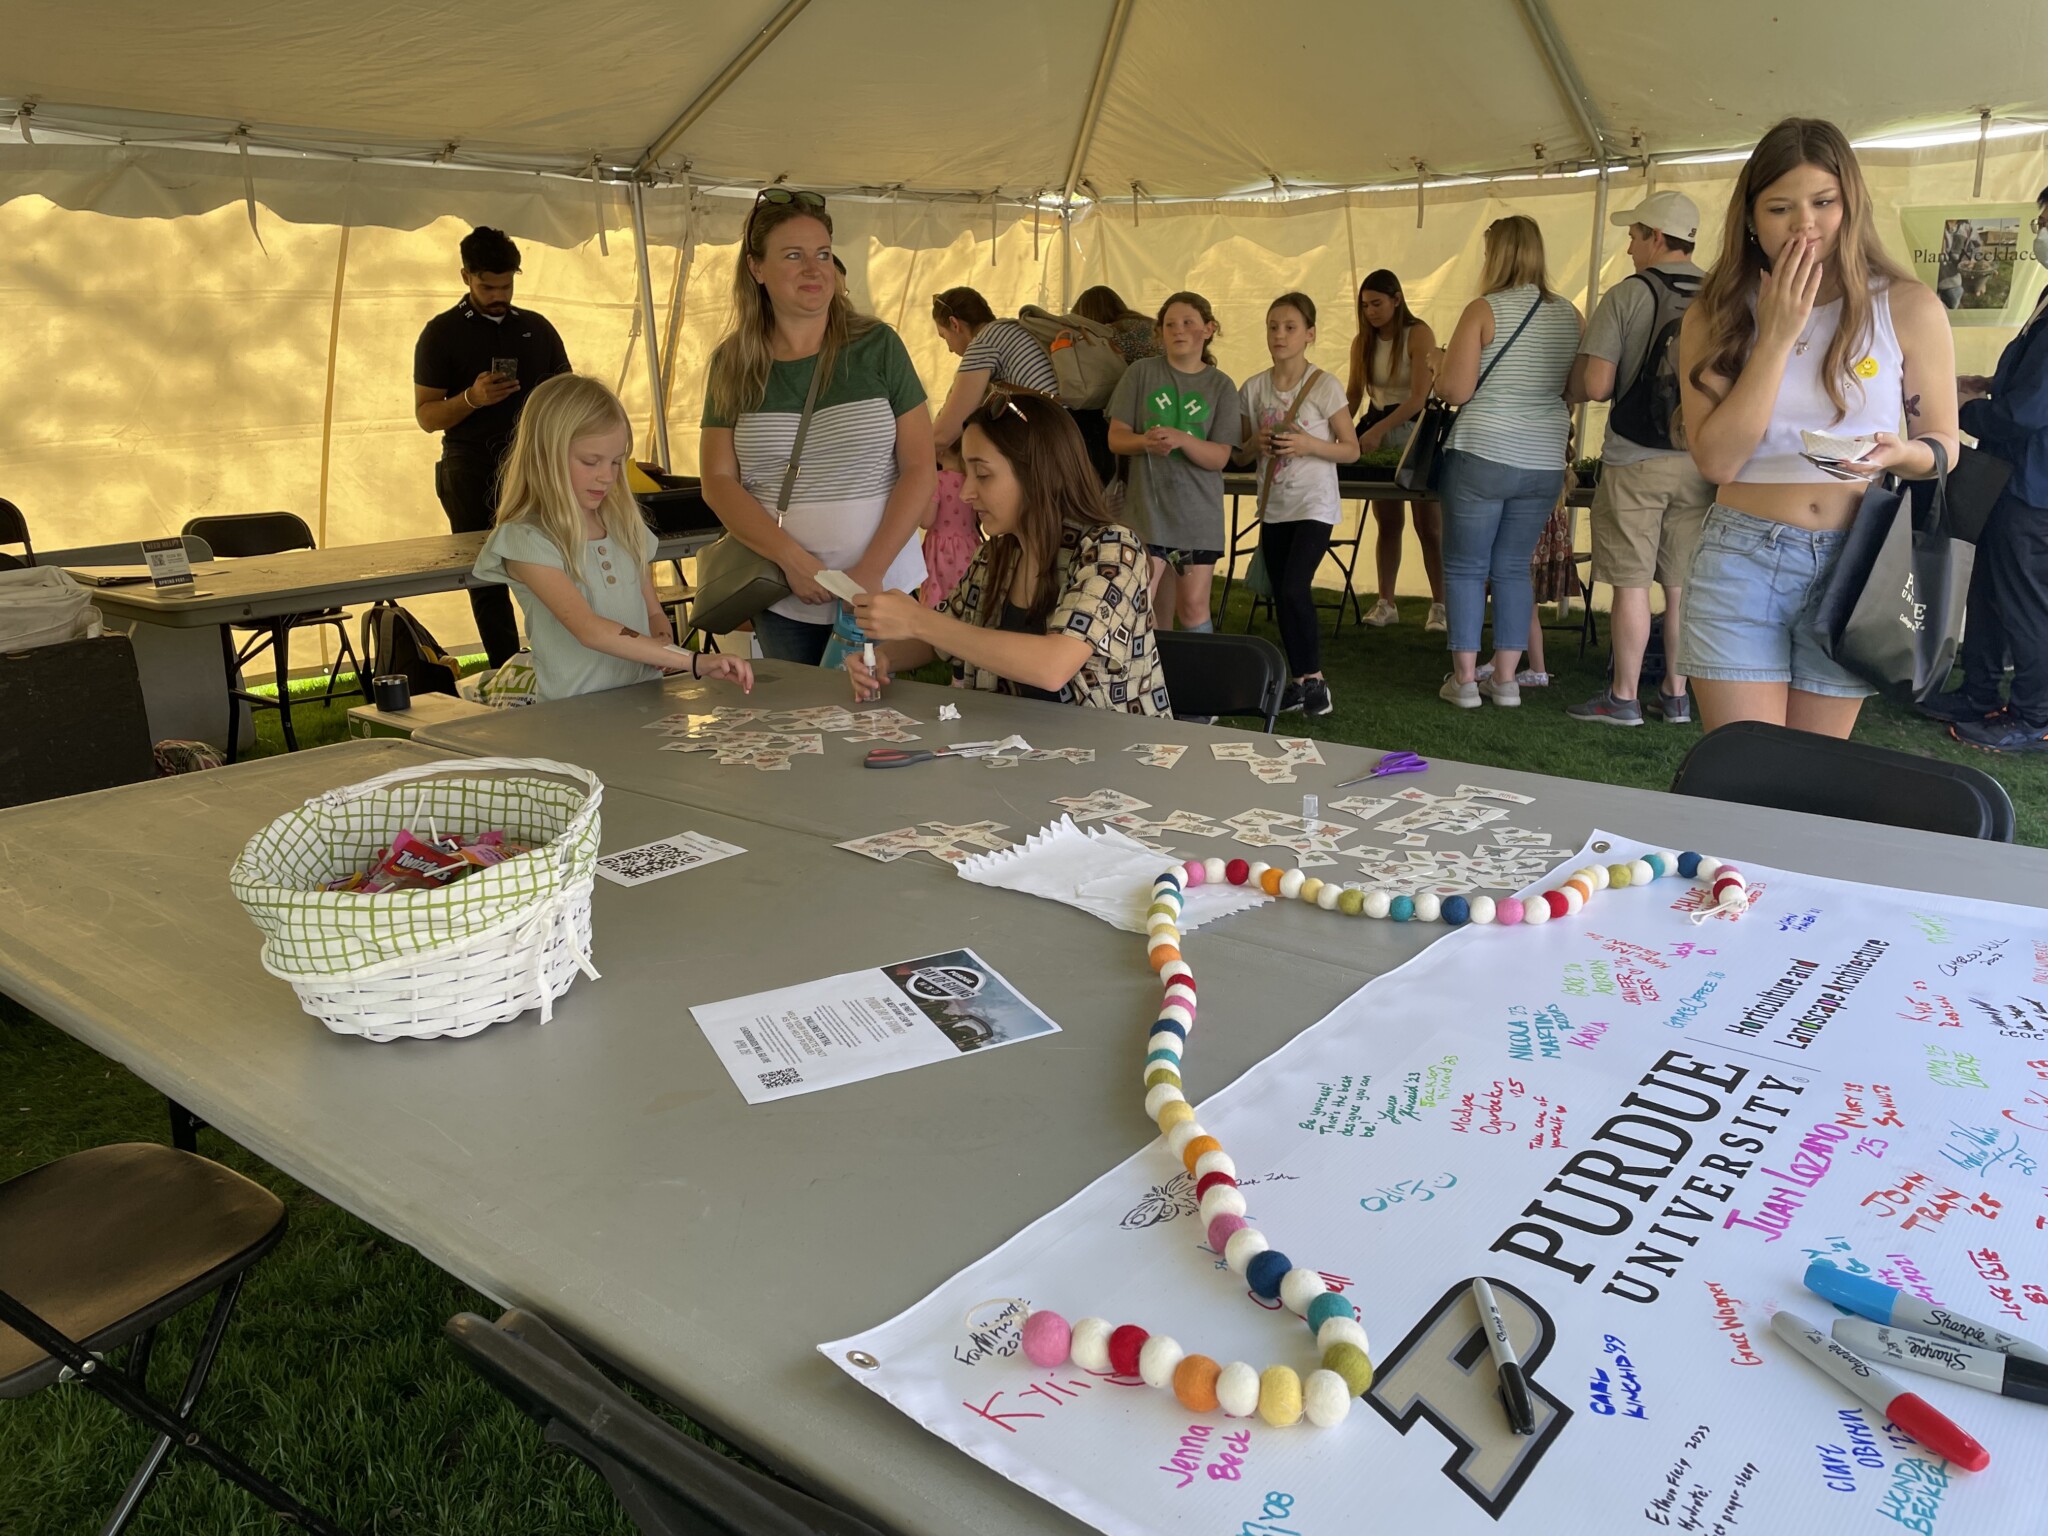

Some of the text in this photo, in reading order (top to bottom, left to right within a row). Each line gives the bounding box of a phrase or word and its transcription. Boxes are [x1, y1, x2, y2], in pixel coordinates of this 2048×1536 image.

[1155, 392, 1172, 410] H
[1184, 399, 1202, 416] H
[916, 967, 942, 978] DAY
[940, 981, 976, 998] GIVING
[1636, 977, 1663, 1002] KERR
[1724, 957, 1821, 1038] Horticulture and
[1772, 939, 1891, 1050] Landscape Architecture
[1507, 1020, 1534, 1062] NICOLA
[1566, 1021, 1610, 1051] KAYLA
[1331, 1094, 1348, 1108] the
[1337, 1075, 1353, 1093] best
[1355, 1088, 1371, 1101] you
[1359, 1075, 1372, 1087] can
[1534, 1095, 1549, 1107] of
[1298, 1118, 1317, 1131] Be
[1489, 1049, 1750, 1285] PURDUE
[1760, 1123, 1850, 1189] LOZANO
[1850, 1136, 1889, 1159] '25
[1359, 1179, 1413, 1213] Odin
[1602, 1074, 1806, 1304] UNIVERSITY
[1859, 1171, 1933, 1218] JOHN
[1899, 1186, 1970, 1234] TRAN
[1722, 1186, 1807, 1243] JUAN
[1703, 1280, 1764, 1366] Grace Wagner
[1923, 1310, 1987, 1345] Sharpie
[1603, 1333, 1649, 1420] KINCAID '99
[1904, 1340, 1973, 1371] Sharpie
[1589, 1367, 1617, 1415] CARL
[1159, 1422, 1215, 1488] Jenna
[1206, 1428, 1250, 1480] Beck
[1875, 1454, 1930, 1525] LUCINDA
[1905, 1453, 1952, 1536] BECKER
